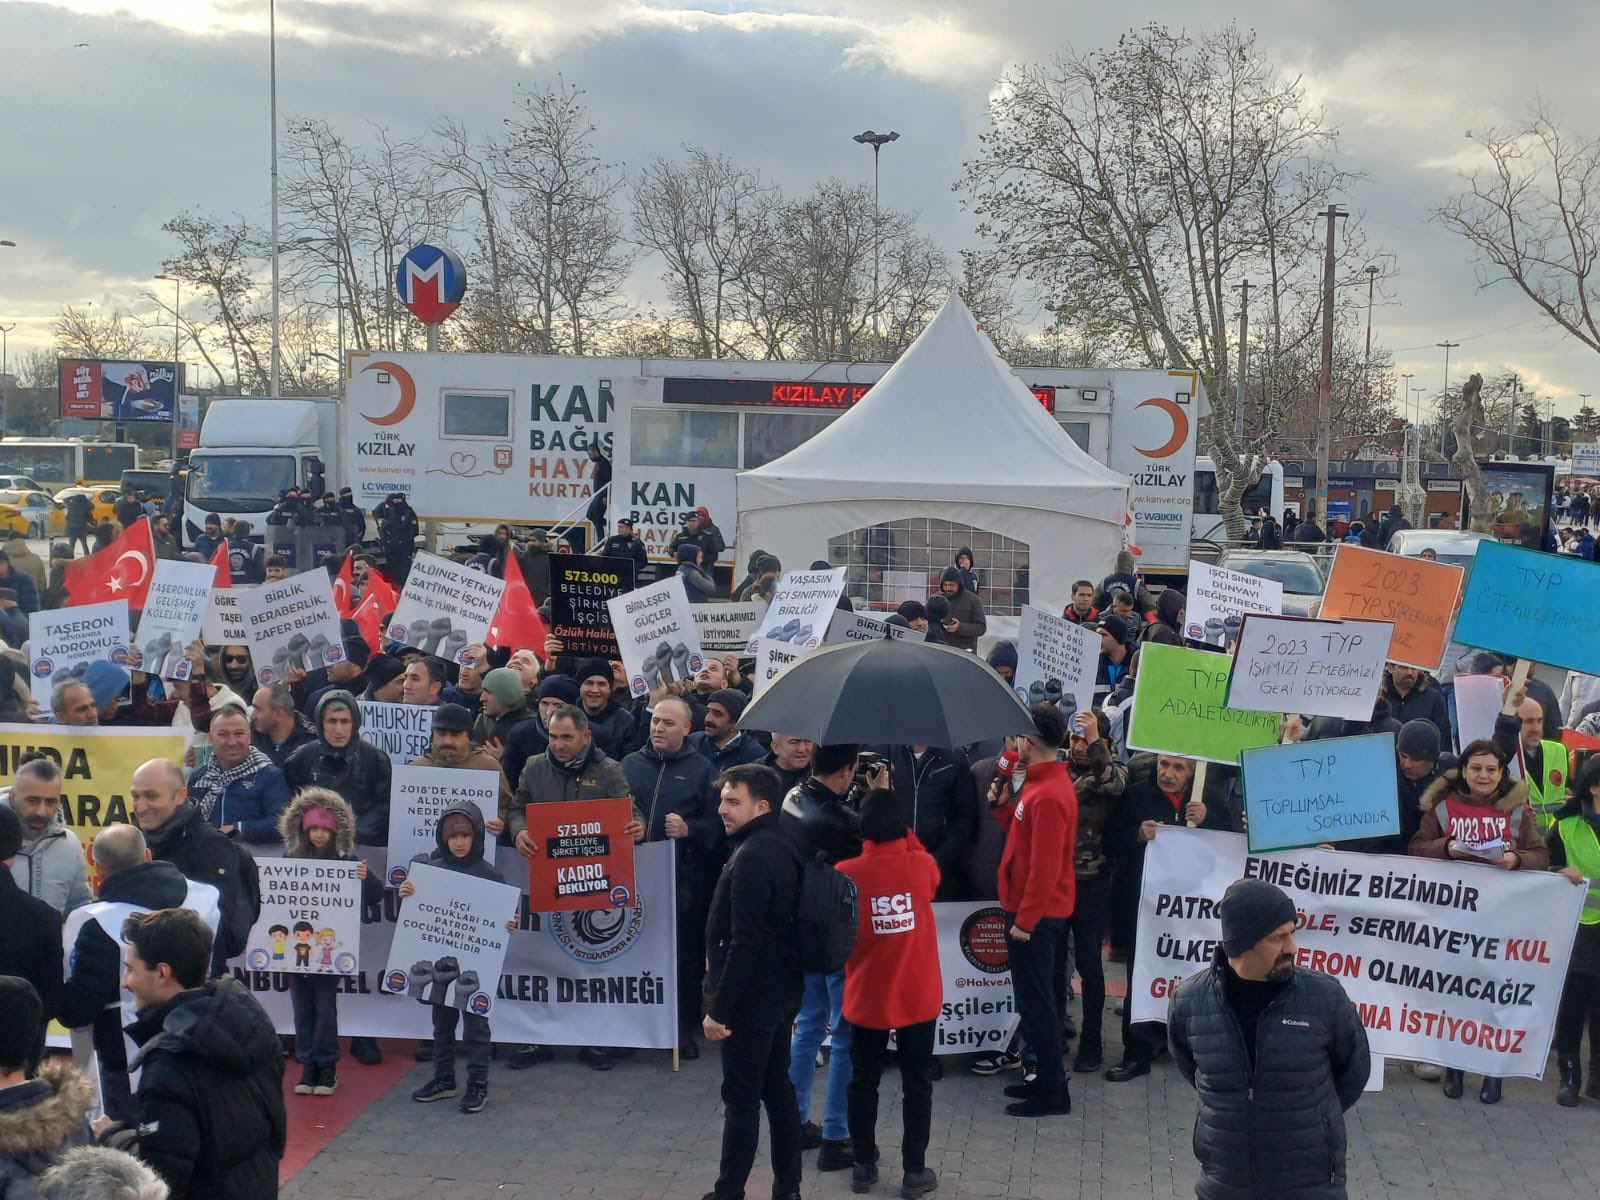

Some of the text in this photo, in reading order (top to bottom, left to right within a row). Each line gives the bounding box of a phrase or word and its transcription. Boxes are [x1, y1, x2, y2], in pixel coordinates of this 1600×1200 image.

[406, 256, 444, 304] M
[772, 384, 846, 404] KIZILAY
[374, 431, 400, 441] TÜRK
[357, 442, 416, 457] KIZILAY
[1146, 464, 1172, 473] TÜRK
[631, 481, 695, 507] KAN
[413, 561, 459, 584] ALDINIZ
[460, 575, 503, 599] YETKİYİ
[564, 570, 618, 585] 573.000
[789, 574, 833, 587] YAŞASIN
[1208, 567, 1229, 580] İŞÇİ
[1360, 562, 1421, 596] 2023
[1516, 566, 1563, 591] TYP
[151, 582, 208, 599] TAŞERONLUK
[265, 583, 305, 604] BİRLİK
[404, 590, 423, 603] HAK
[410, 577, 495, 612] SATTINIZ İŞÇİYİ
[791, 588, 840, 602] SINIFININ
[1211, 580, 1259, 599] DÜNYAYI
[155, 596, 197, 613] GELİŞMİŞ
[625, 590, 672, 615] BİRLEŞEN
[778, 603, 818, 619] BİRLİĞİ!
[1196, 587, 1273, 614] DEĞİŞTİRECEK
[1344, 591, 1381, 616] TYP
[44, 616, 114, 638] TAŞERON
[634, 607, 672, 629] GÜÇLER
[710, 611, 756, 627] HAKLARIMIZI
[1038, 613, 1072, 631] DEDİNİZ
[254, 622, 292, 643] ZAFER
[554, 624, 586, 639] Özlük
[703, 627, 740, 643] İSTİYORUZ
[1033, 630, 1059, 646] SEÇİM
[1038, 622, 1064, 639] SEÇİM
[40, 635, 120, 657] KADROMUZ
[1036, 642, 1081, 666] NE OLACAK
[1258, 630, 1363, 657] 2023 TYP
[1032, 648, 1083, 678] BELEDİYE VE
[1033, 658, 1079, 686] TAŞERONUN
[1247, 656, 1380, 687] İŞİMİZİ EMEĞİMİZİ
[1185, 666, 1229, 692] TYP
[1258, 678, 1363, 699] GERİ İSTİYORUZ
[1289, 755, 1337, 781] TYP
[400, 784, 494, 799] 2018'DE KADRO
[1258, 793, 1346, 819] TOPLUMSAL
[557, 821, 602, 838] 573.000
[1305, 809, 1392, 834] SORUNDUR
[1451, 816, 1507, 842] 2023 TYP
[552, 844, 606, 859] ŞİRKET İŞÇİSİ
[560, 836, 599, 848] BELEDİYE
[316, 868, 356, 880] DEDE
[557, 863, 604, 884] KADRO
[269, 880, 341, 894] BABAMIN
[558, 878, 609, 895] BEKLİYOR
[1243, 856, 1480, 913] EMEĞİMİZ BİZİMDİR
[289, 909, 320, 921] VER
[449, 898, 472, 912] İŞÇİ
[418, 902, 479, 926] ÇOCUKLARI
[482, 918, 497, 930] DA
[434, 916, 477, 934] PATRON
[873, 916, 913, 932] Haber
[402, 918, 502, 951] ÇOCUKLARI KADAR
[420, 932, 481, 955] SEVİMLİDİR
[1348, 915, 1500, 962] SERMAYE'YE
[1504, 938, 1552, 965] KUL
[556, 970, 664, 1005] DERNEĞİ
[1368, 958, 1537, 1007] OLMAYACAĞIZ
[1399, 1002, 1528, 1055] İSTİYORUZ
